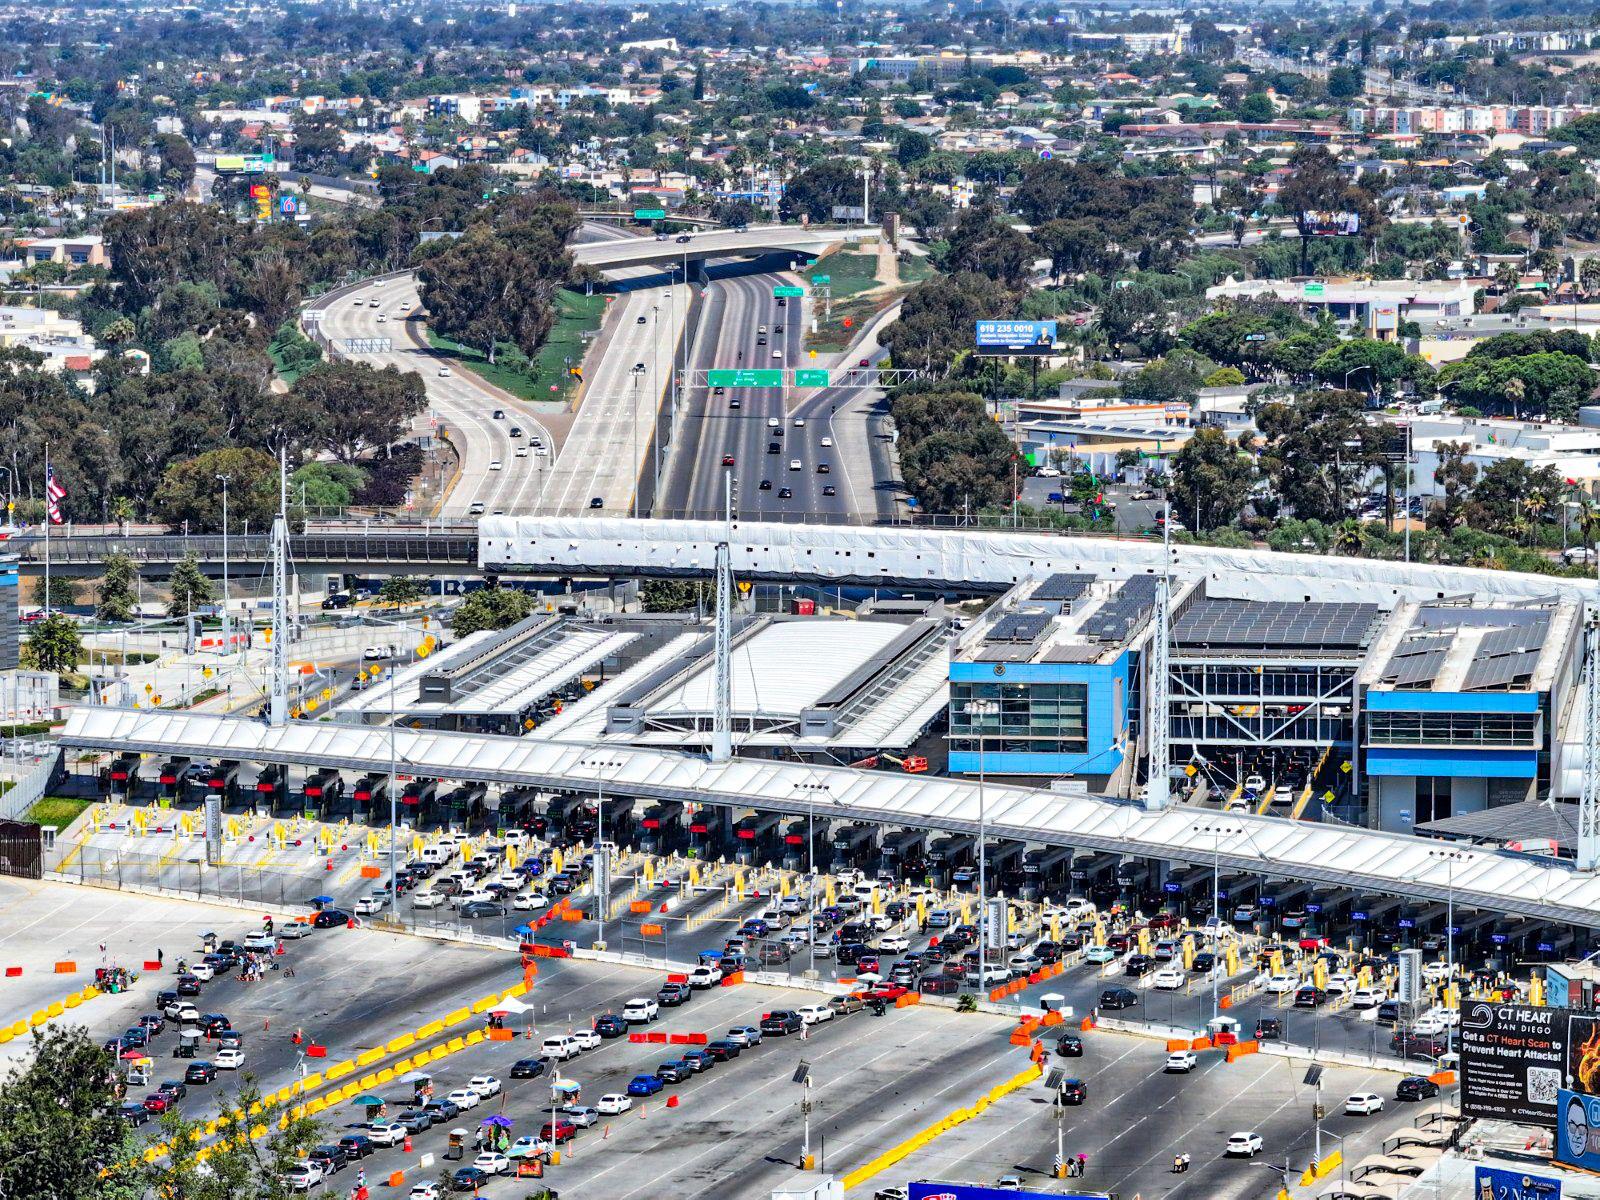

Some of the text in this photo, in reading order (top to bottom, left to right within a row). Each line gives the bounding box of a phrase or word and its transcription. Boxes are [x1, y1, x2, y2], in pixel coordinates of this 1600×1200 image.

[284, 195, 294, 212] 6
[980, 324, 1033, 332] 619 235 0010
[1498, 1008, 1552, 1024] CT HEART
[1498, 1022, 1551, 1034] SAN DIEGO
[1462, 1031, 1478, 1041] Get
[1486, 1034, 1499, 1042] CT
[1501, 1036, 1526, 1046] Heart
[1527, 1038, 1550, 1048] Scan
[1552, 1041, 1562, 1050] to
[1462, 1043, 1562, 1061] Prevent Heart Attacks!
